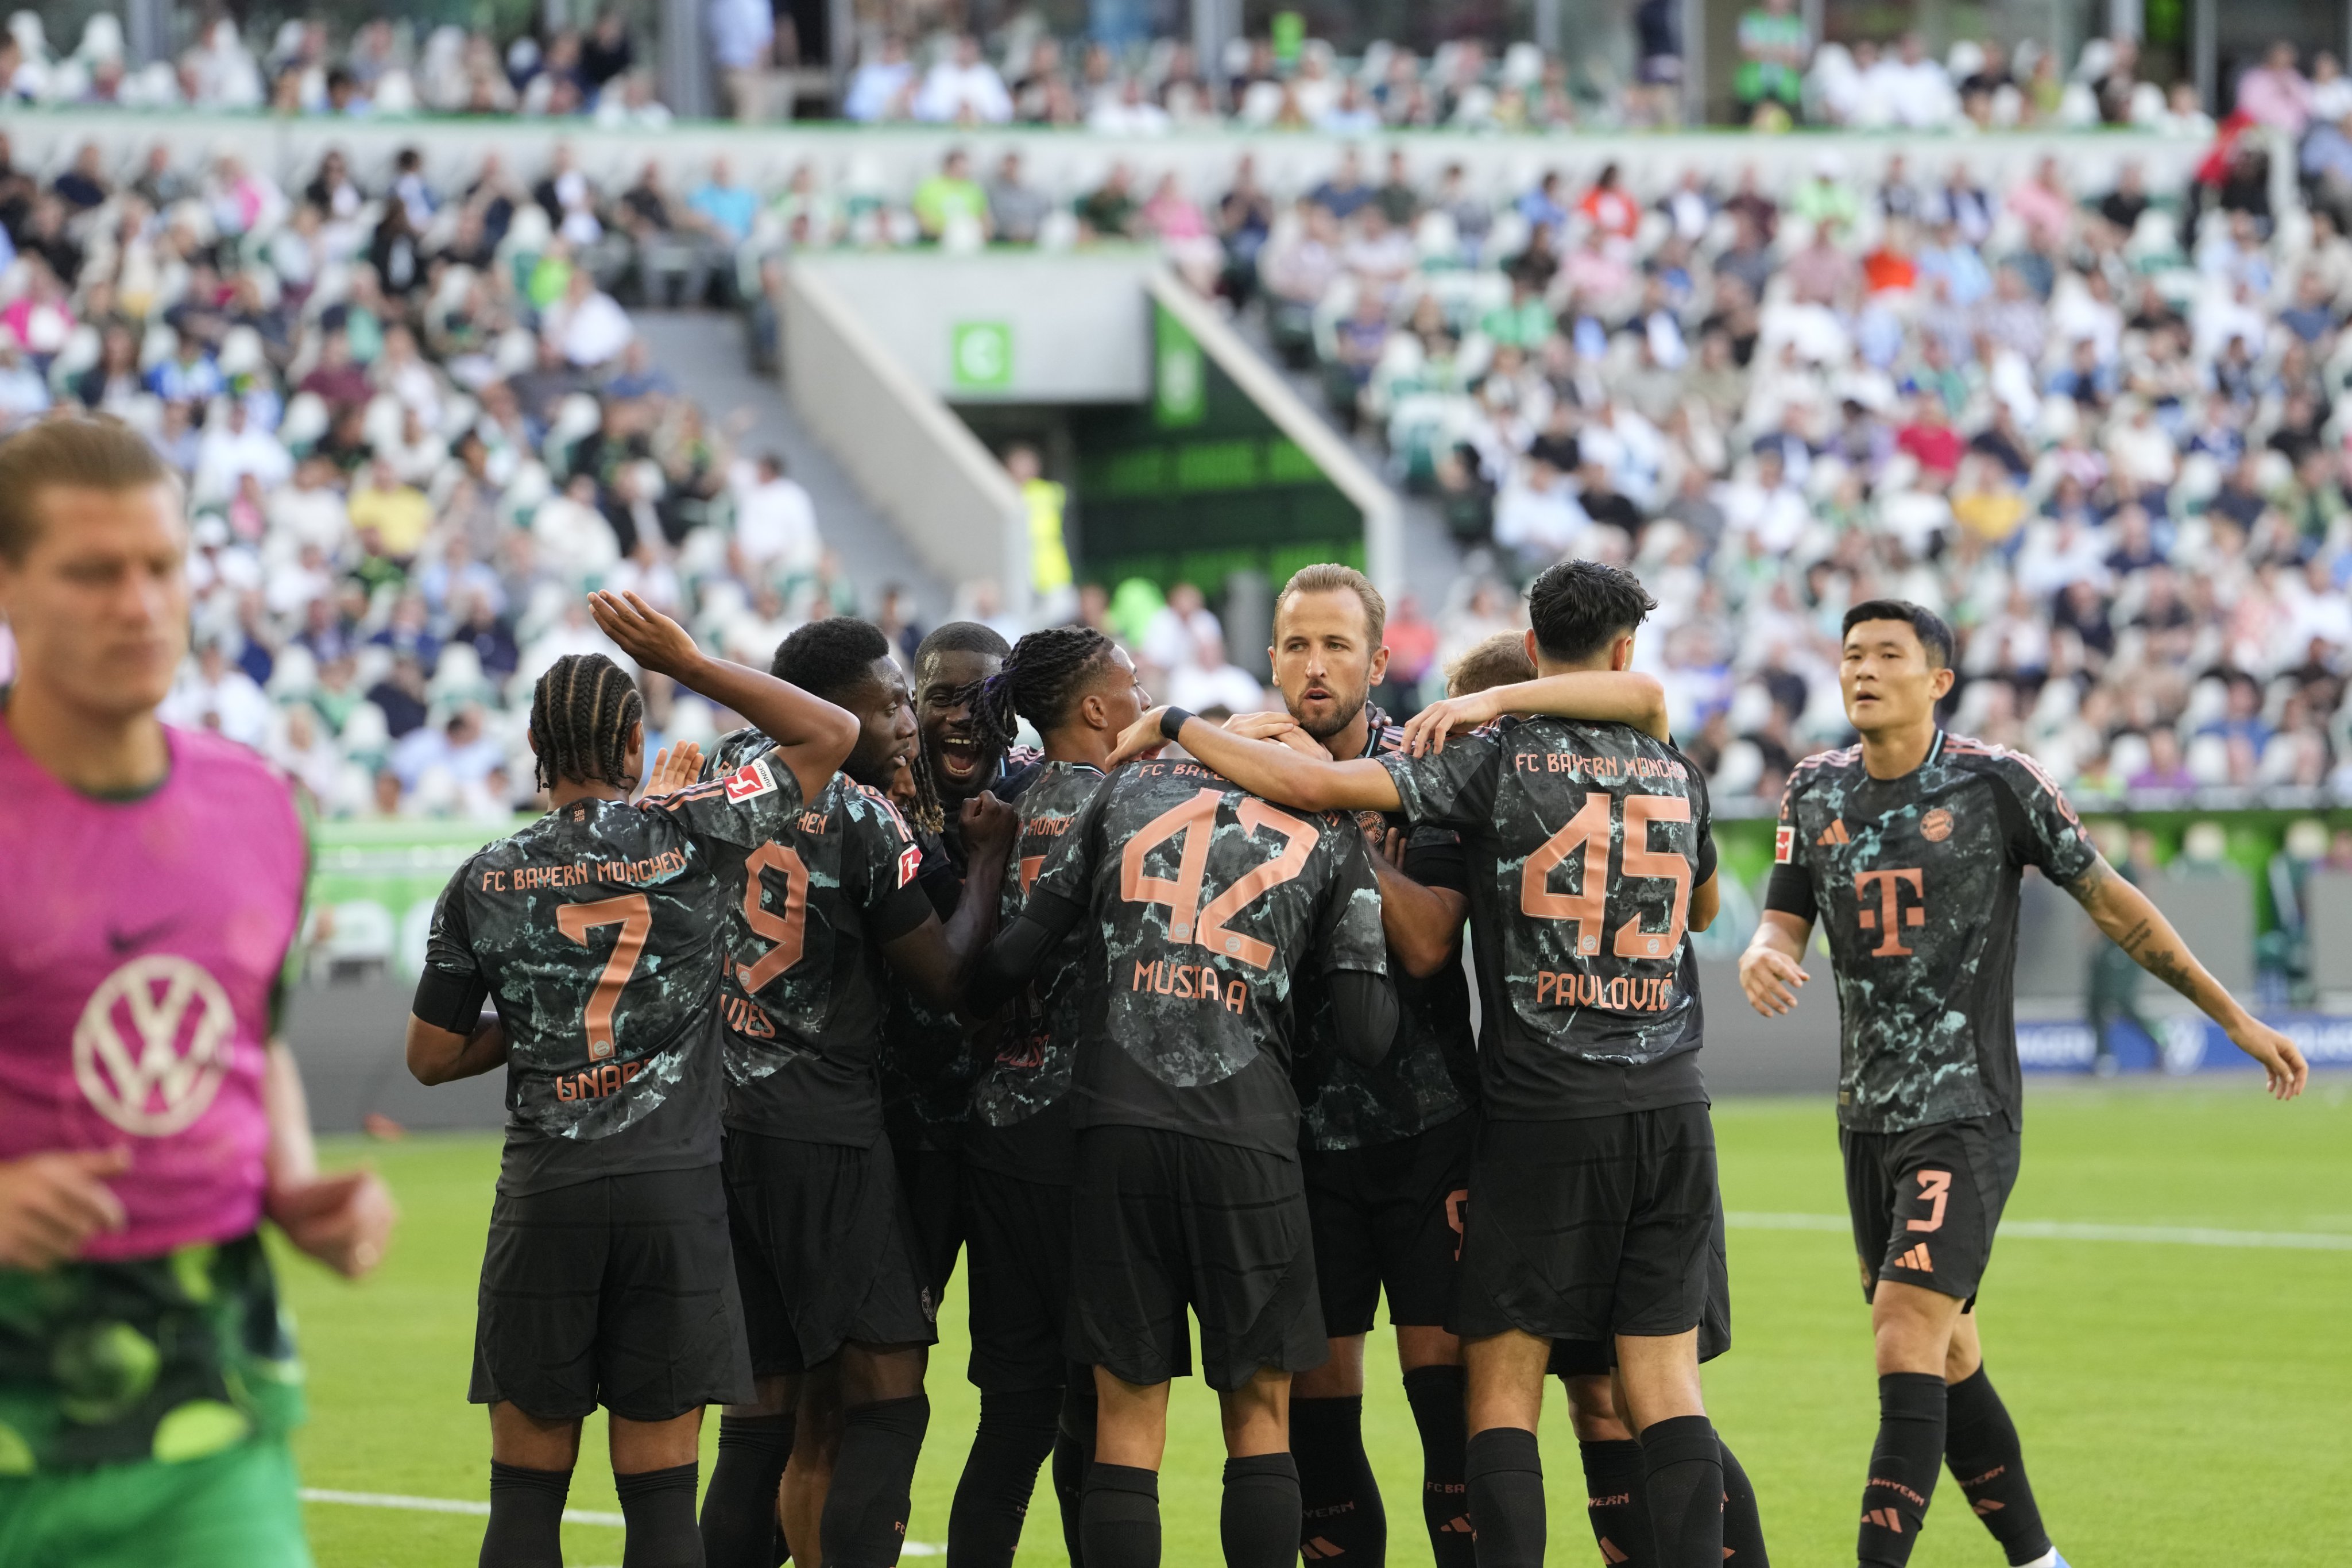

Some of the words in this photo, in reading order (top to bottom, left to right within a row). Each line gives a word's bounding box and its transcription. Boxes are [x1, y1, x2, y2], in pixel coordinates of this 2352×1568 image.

[1139, 764, 1165, 778] FC
[1515, 753, 1540, 773] FC
[1546, 753, 1618, 778] BAYERN
[574, 808, 585, 817] SAN
[482, 870, 506, 892] FC
[513, 862, 589, 891] BAYERN
[597, 847, 687, 883] MÜNCHEN
[1120, 787, 1320, 971] 42
[1521, 792, 1692, 959] 45
[722, 838, 810, 995] 9
[1854, 868, 1925, 957] T
[556, 892, 653, 1063] 7
[1132, 959, 1247, 1015] MUSIAA
[1537, 971, 1673, 1011] PAVLOVIĆ
[1906, 1169, 1952, 1233] 3
[1301, 1500, 1355, 1519] YERN
